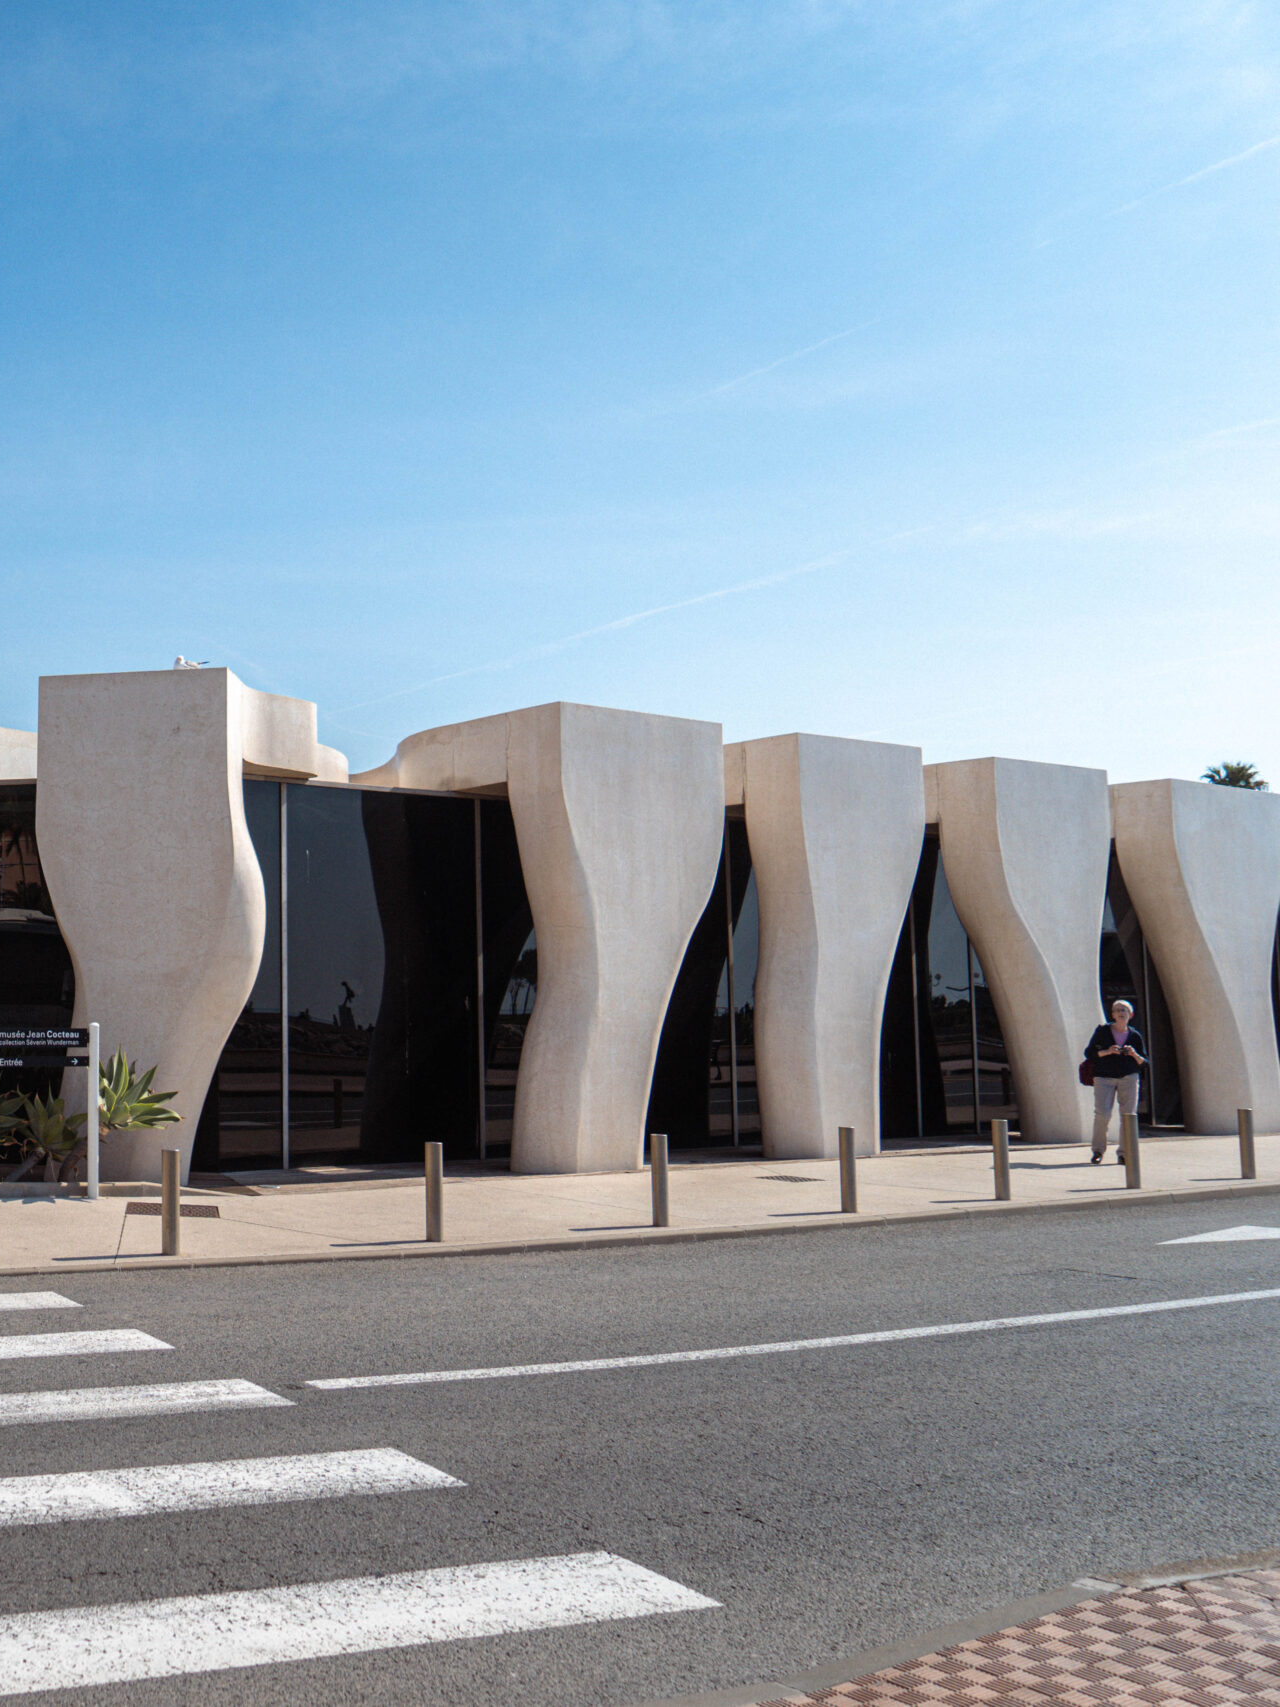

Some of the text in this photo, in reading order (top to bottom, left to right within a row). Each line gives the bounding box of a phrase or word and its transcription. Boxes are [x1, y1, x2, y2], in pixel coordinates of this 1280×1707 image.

[0, 1030, 25, 1038] musée
[26, 1030, 46, 1038] Jean
[46, 1030, 80, 1038] Cocteau
[0, 1058, 23, 1066] Entrée
